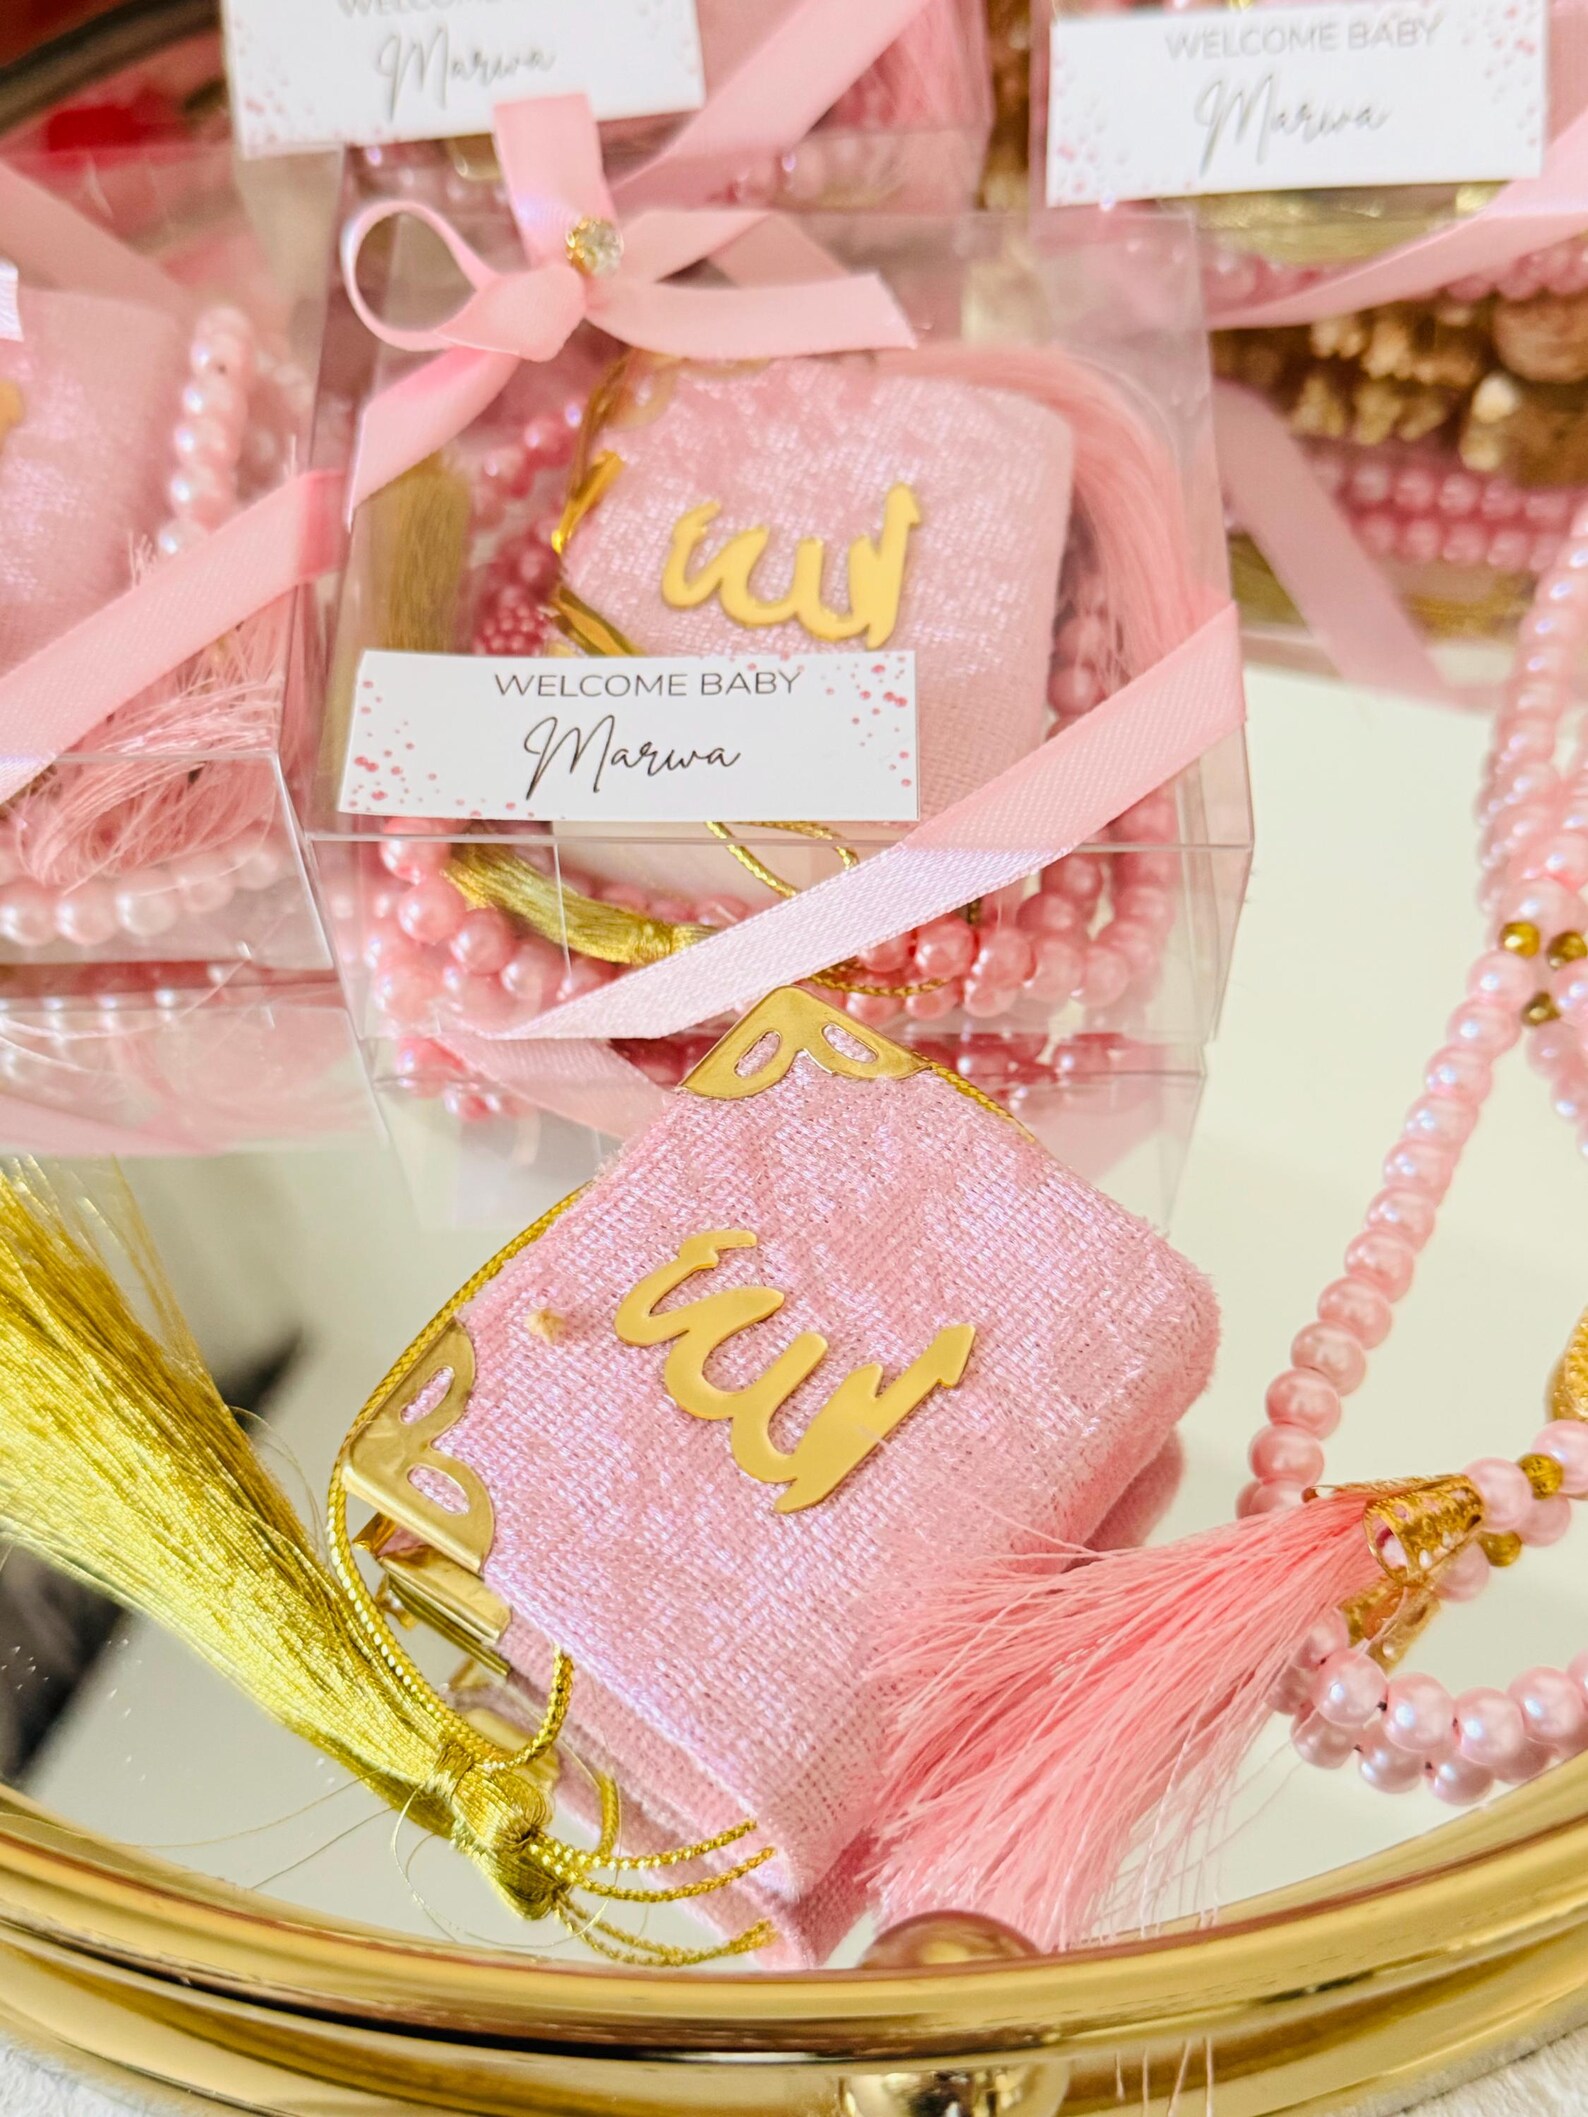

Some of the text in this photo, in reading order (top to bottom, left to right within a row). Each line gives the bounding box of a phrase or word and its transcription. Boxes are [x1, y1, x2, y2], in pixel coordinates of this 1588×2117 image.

[376, 26, 556, 121] Marwa
[1168, 18, 1442, 60] WELCOME BABY
[1194, 74, 1387, 177] Marwa
[494, 672, 802, 697] WELCOME BABY
[523, 714, 741, 800] Marwa
